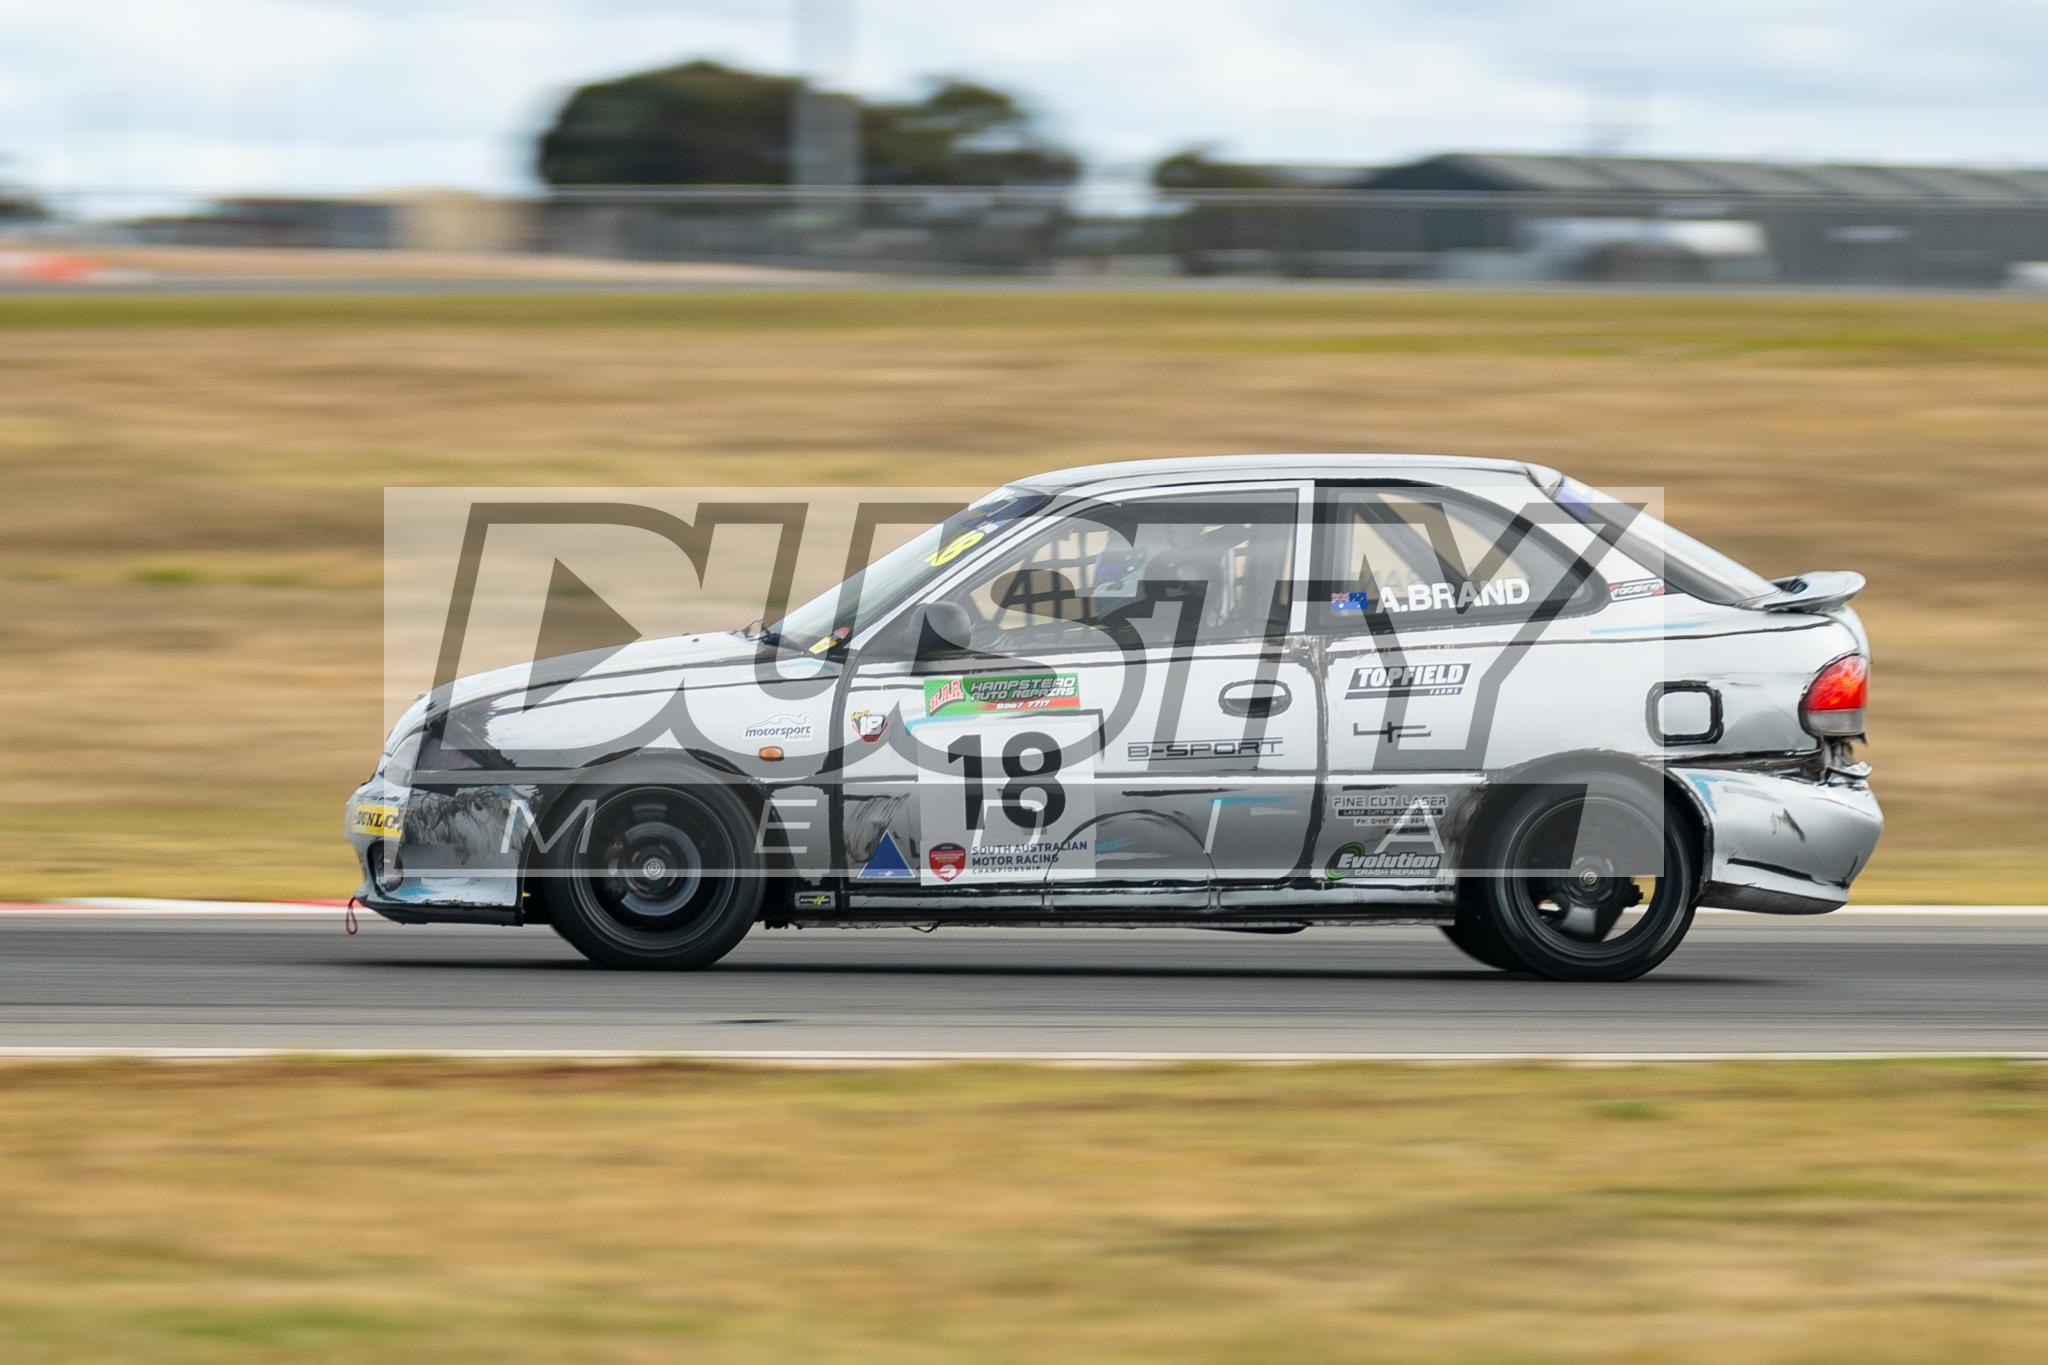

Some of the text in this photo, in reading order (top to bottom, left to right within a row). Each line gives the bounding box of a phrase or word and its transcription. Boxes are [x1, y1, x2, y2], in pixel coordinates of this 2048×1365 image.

[1376, 578, 1530, 614] A.BRAND
[1358, 664, 1464, 687] TOPFIELD
[971, 677, 1076, 692] HAMPSTEAD
[971, 687, 1075, 701] AUTO REPAIRS
[745, 726, 812, 739] motorsport
[1127, 741, 1284, 758] B-SPORT
[947, 730, 1067, 831] 18
[1334, 795, 1447, 807] FINE CUT LASER
[971, 841, 1088, 856] SOUTH AUSTRALIAN
[972, 855, 1013, 867] MOTOR
[1016, 853, 1060, 865] RACING
[1337, 852, 1440, 869] Evolution
[972, 865, 1042, 875] CHAMPIONSHIP
